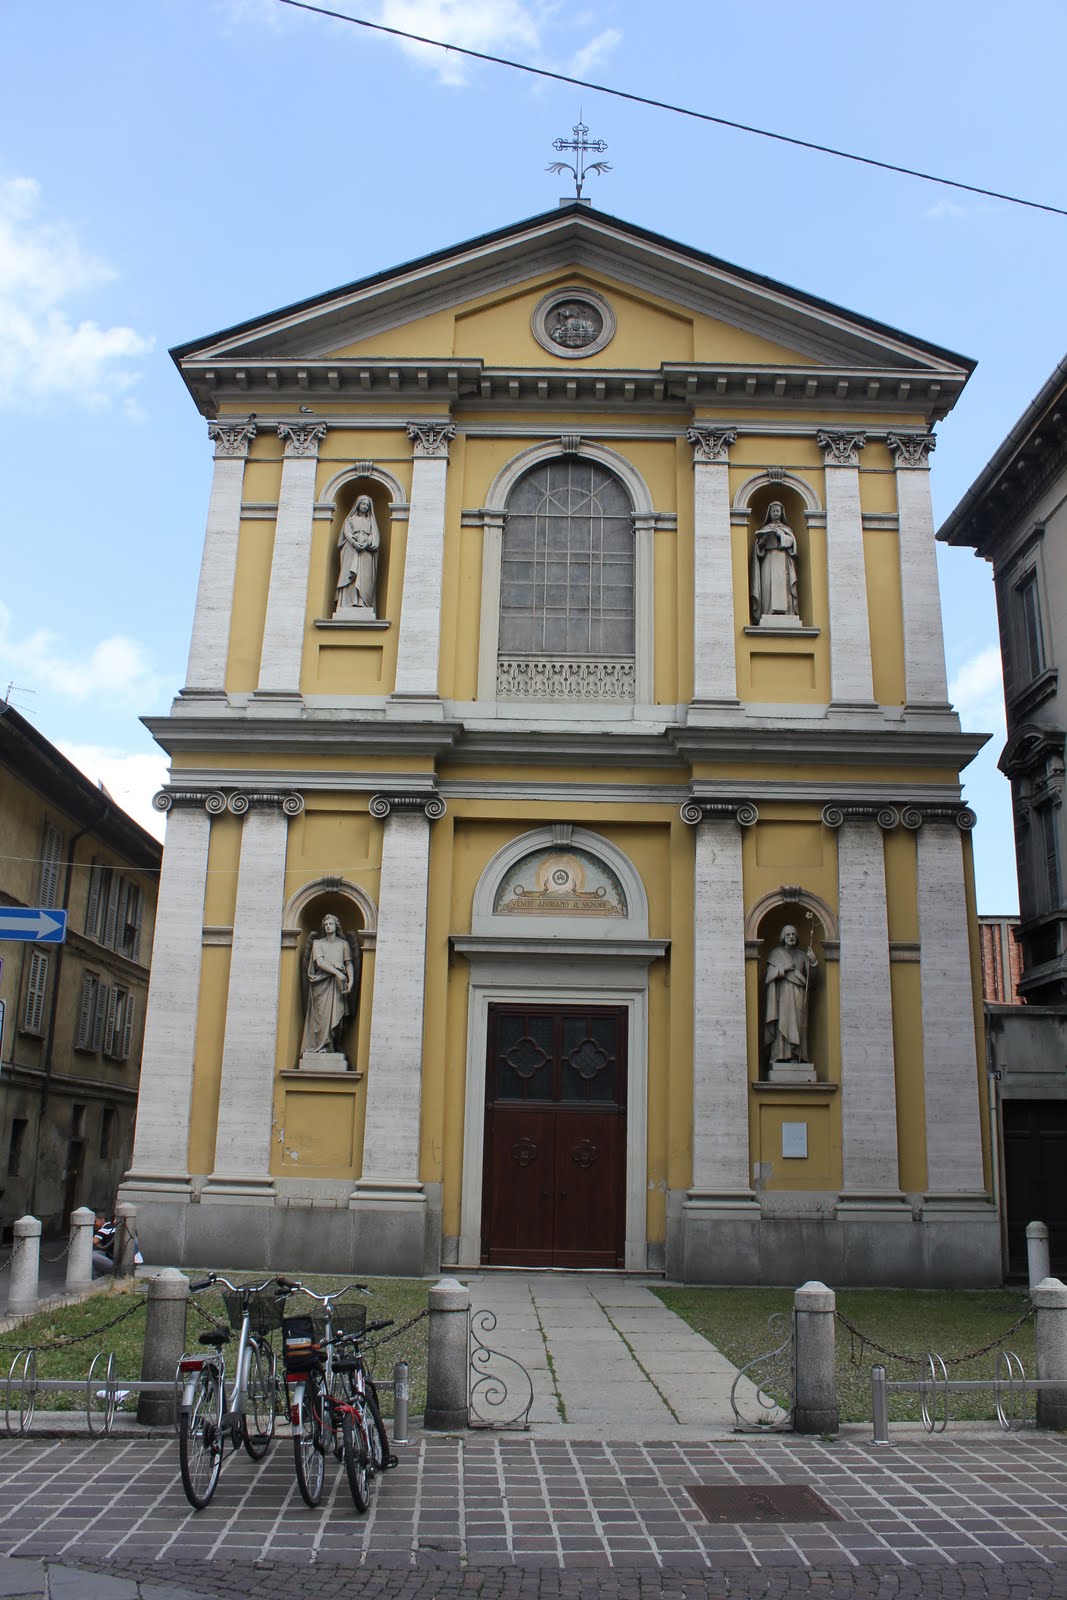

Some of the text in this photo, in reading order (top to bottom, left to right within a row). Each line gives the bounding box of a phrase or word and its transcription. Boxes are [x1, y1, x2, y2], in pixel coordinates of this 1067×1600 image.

[512, 900, 607, 909] VENITE ADORIAMO IL SIGNORE
